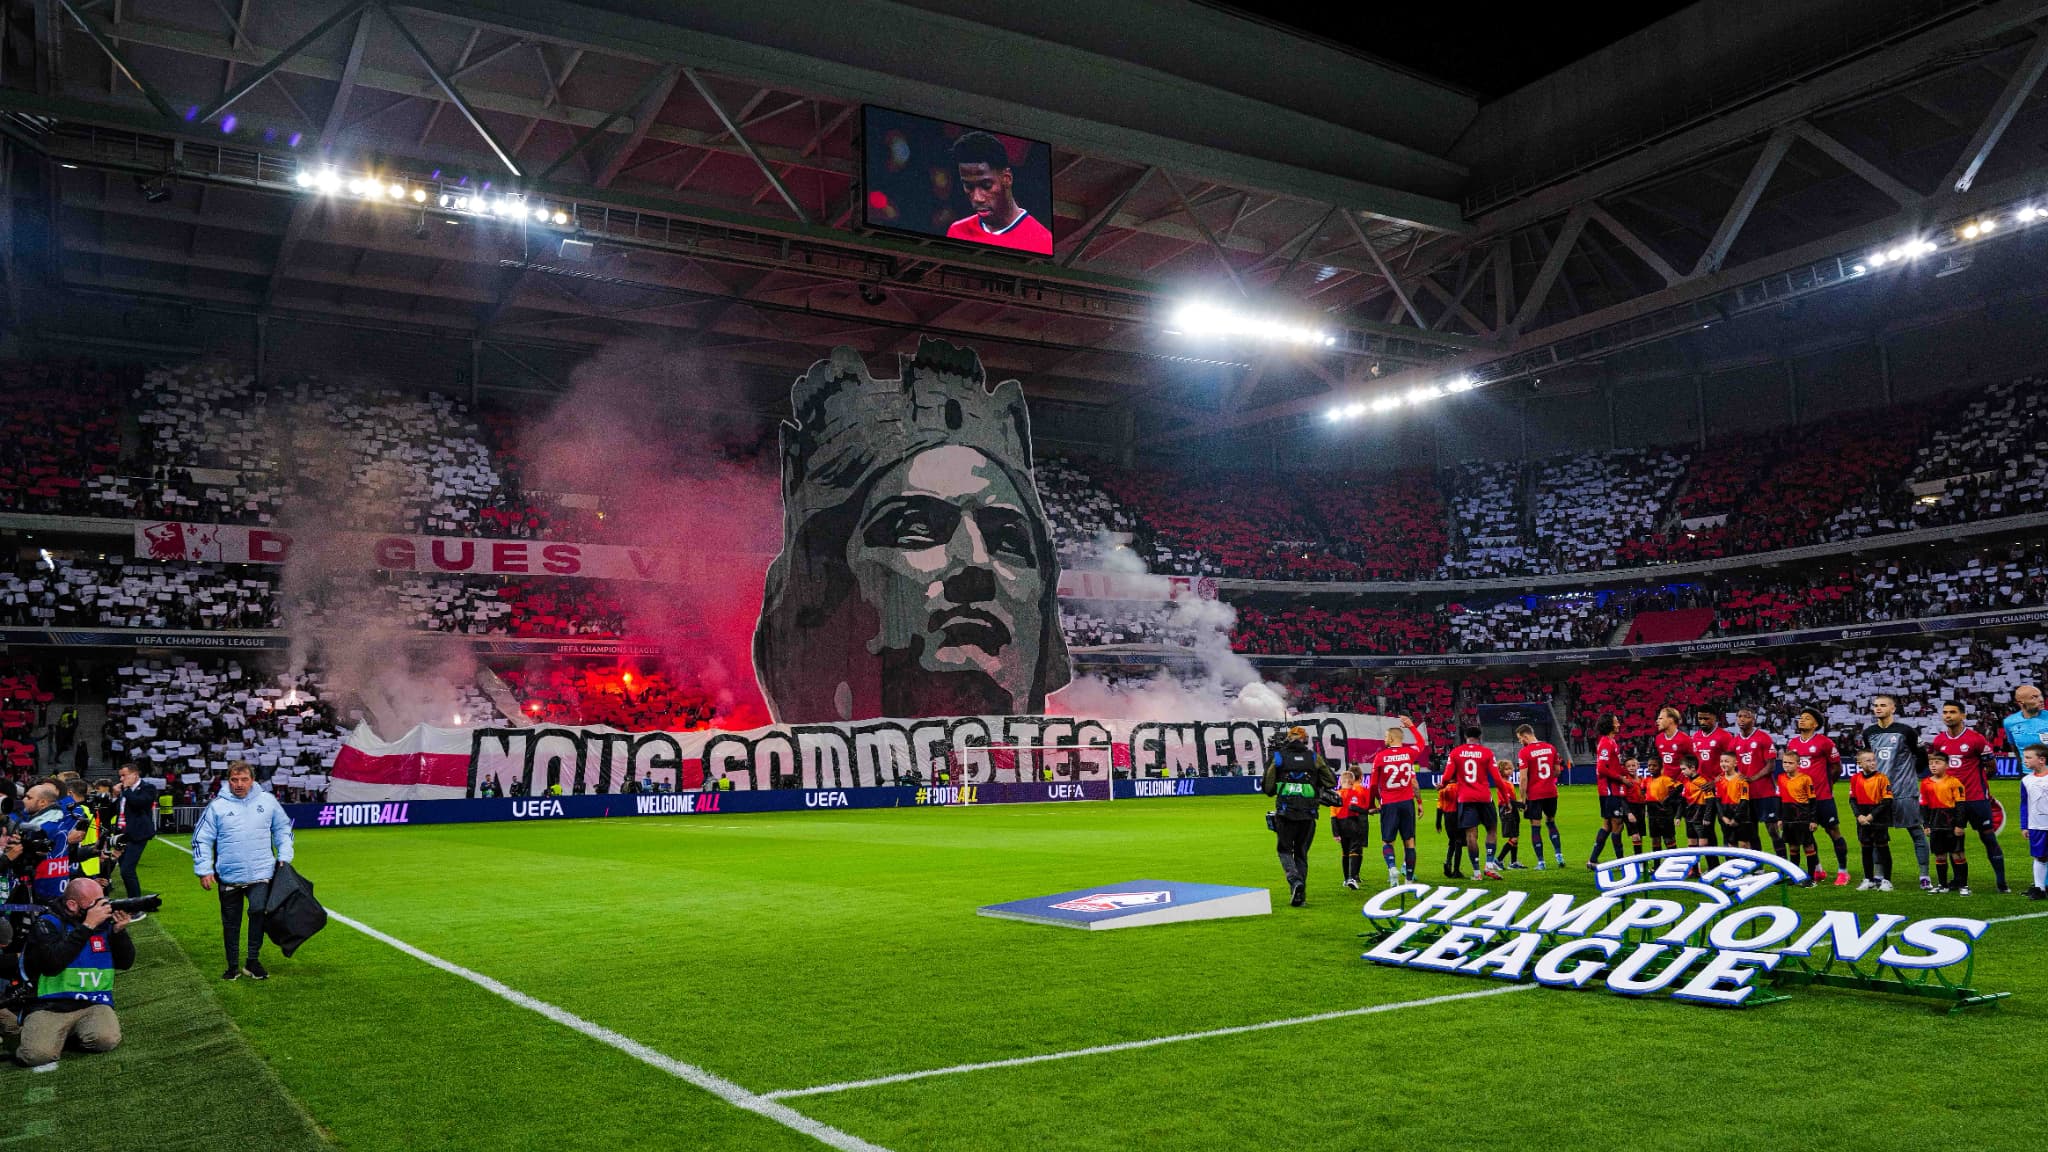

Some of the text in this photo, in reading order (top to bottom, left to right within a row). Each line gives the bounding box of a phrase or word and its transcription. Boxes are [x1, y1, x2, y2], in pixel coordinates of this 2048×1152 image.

[249, 529, 581, 575] DGUES
[136, 636, 265, 647] UEFA CHAMPIONS LEAGUE
[1130, 717, 1350, 779] ENFAS
[1383, 762, 1412, 789] 23
[1464, 759, 1478, 784] 9
[1537, 756, 1551, 780] 5
[1995, 758, 2020, 776] ALL
[805, 791, 849, 807] UEFA
[915, 785, 978, 805] #FOOTBALL
[1048, 784, 1084, 799] UEFA
[1135, 779, 1195, 797] WELCOME ALL
[317, 803, 409, 826] #FOOTBALL
[512, 800, 565, 818] UEFA
[636, 793, 721, 814] WELCOME ALL
[1597, 854, 1783, 904] UEFA
[1362, 883, 1990, 970] CHAMPIONS
[1361, 921, 1782, 1004] LEAGUE
[78, 971, 103, 988] TV
